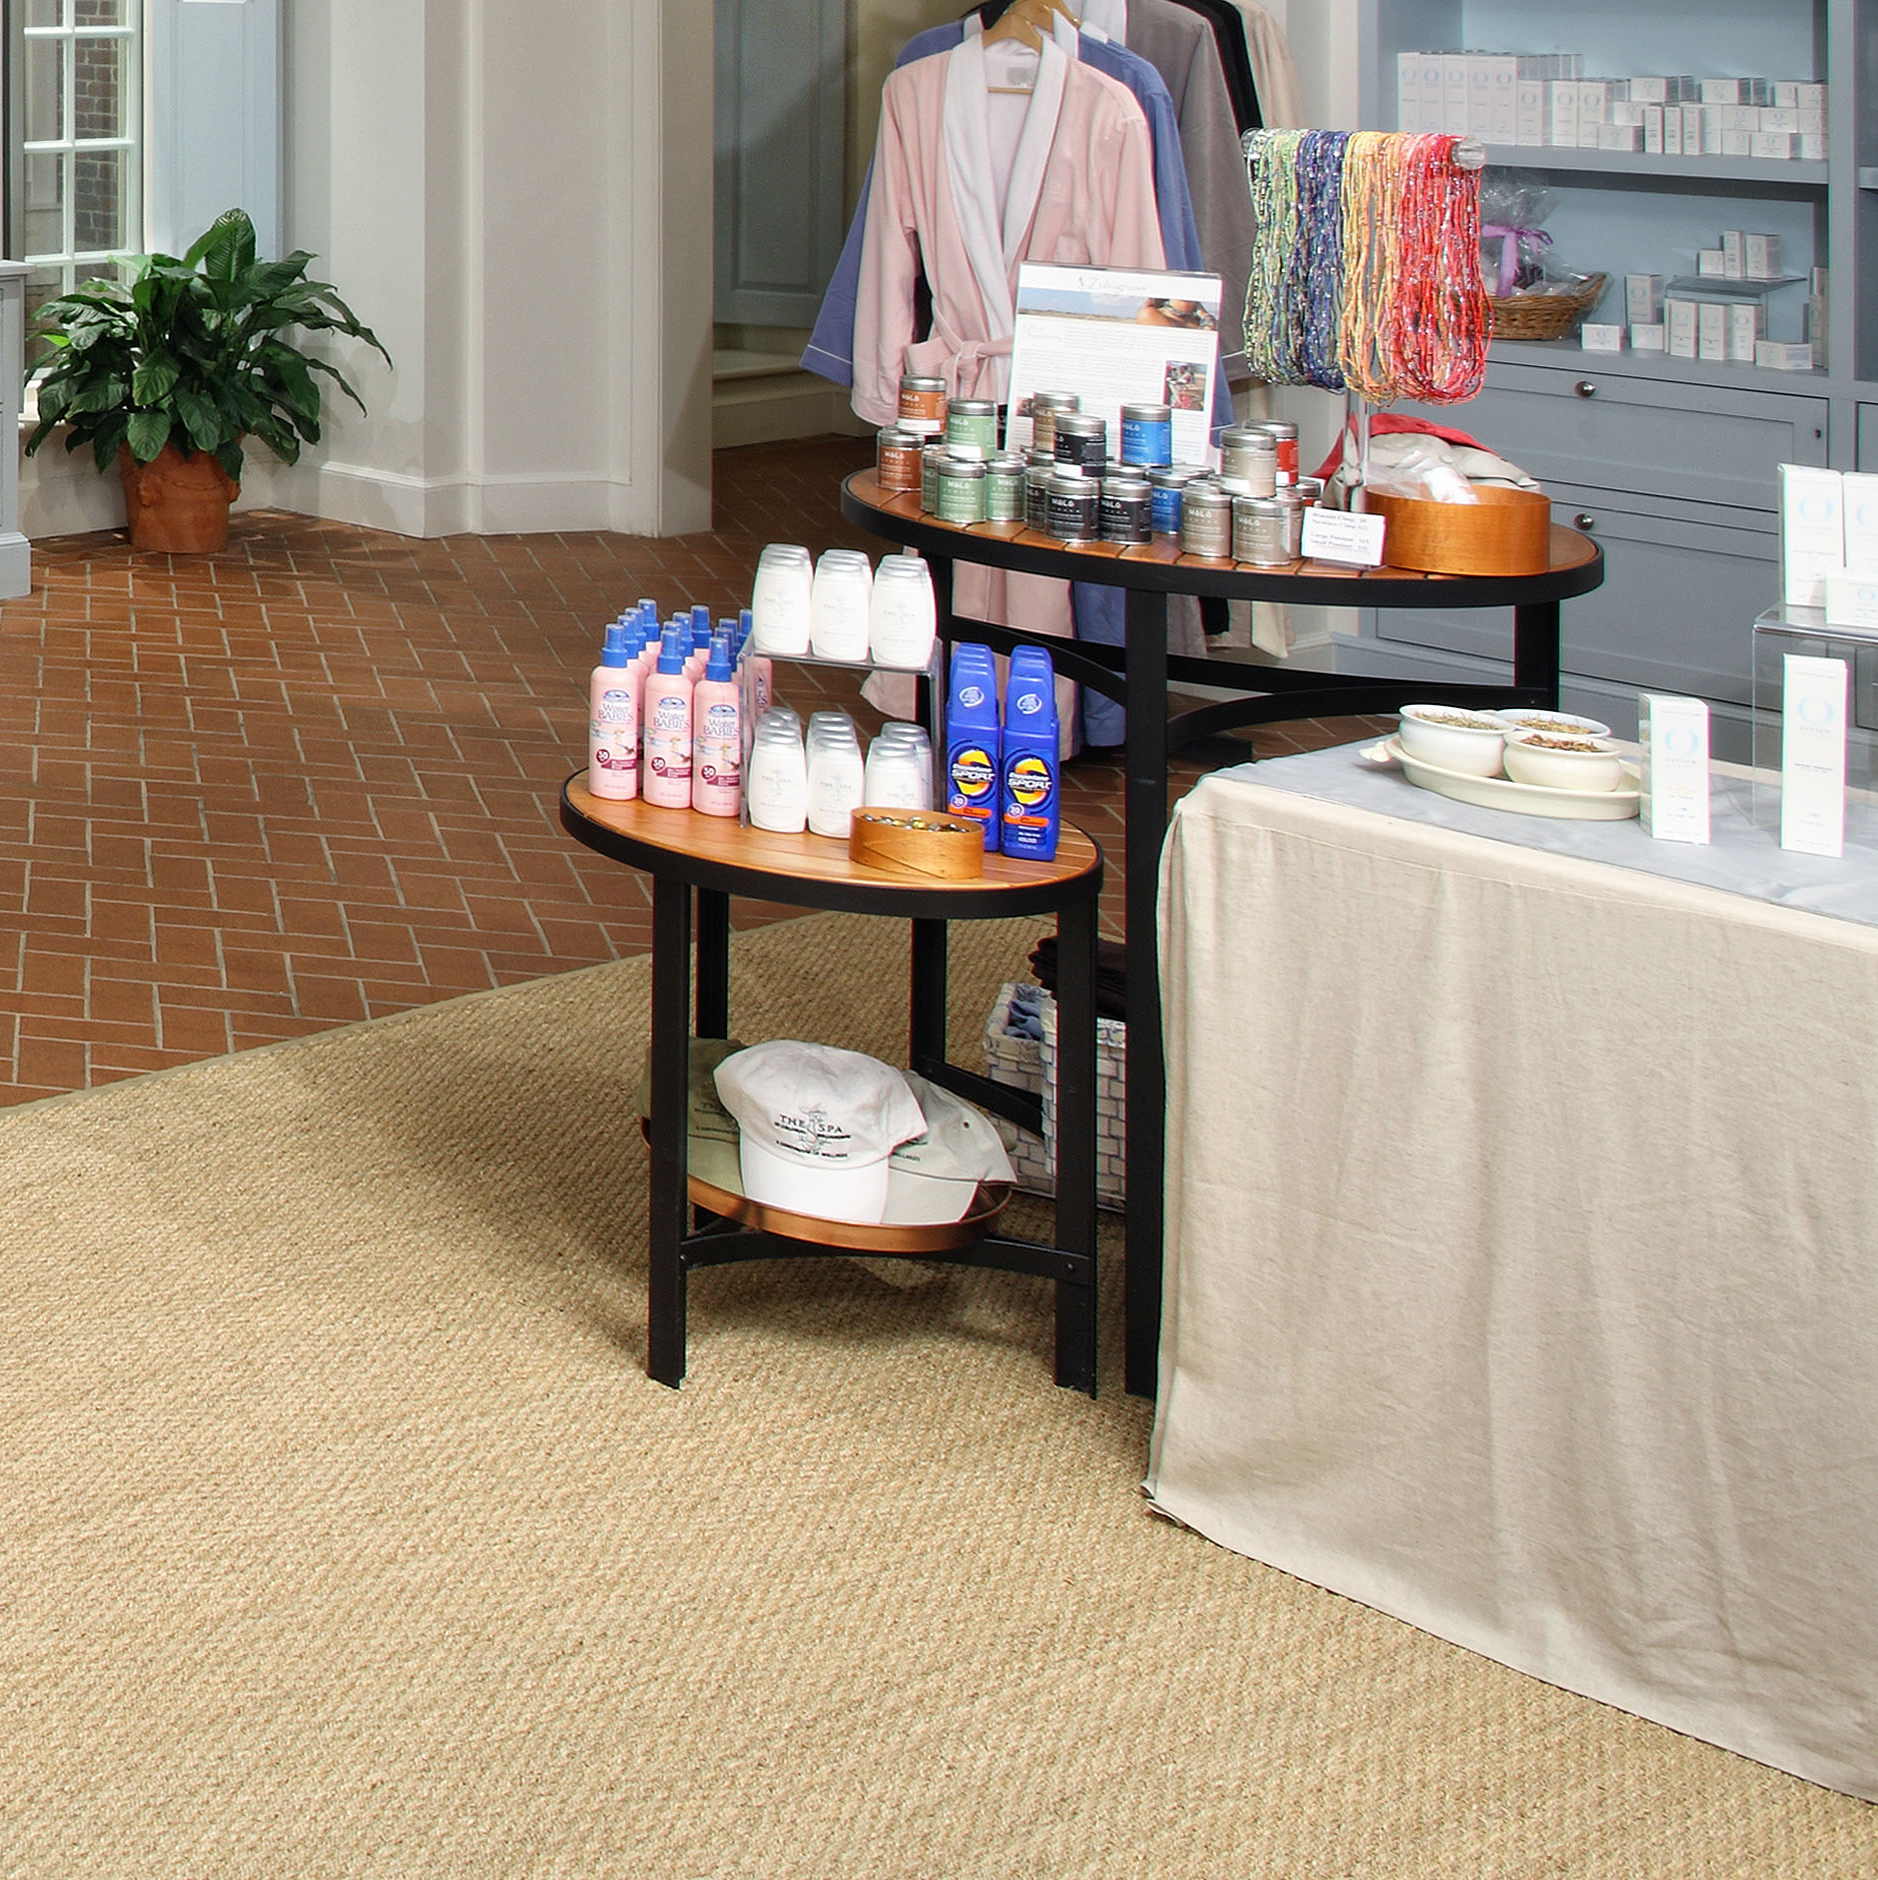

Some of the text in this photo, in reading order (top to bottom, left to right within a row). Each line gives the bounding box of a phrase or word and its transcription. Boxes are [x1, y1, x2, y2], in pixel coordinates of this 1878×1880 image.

[603, 703, 629, 713] Water
[598, 710, 634, 720] BABIES
[658, 711, 685, 720] Water
[653, 717, 690, 728] BABIES
[708, 718, 735, 728] Water
[703, 725, 738, 736] BABIES
[952, 770, 995, 781] SPORT
[1008, 779, 1052, 790] SPORT
[780, 1114, 805, 1128] THE
[818, 1123, 843, 1133] SPA
